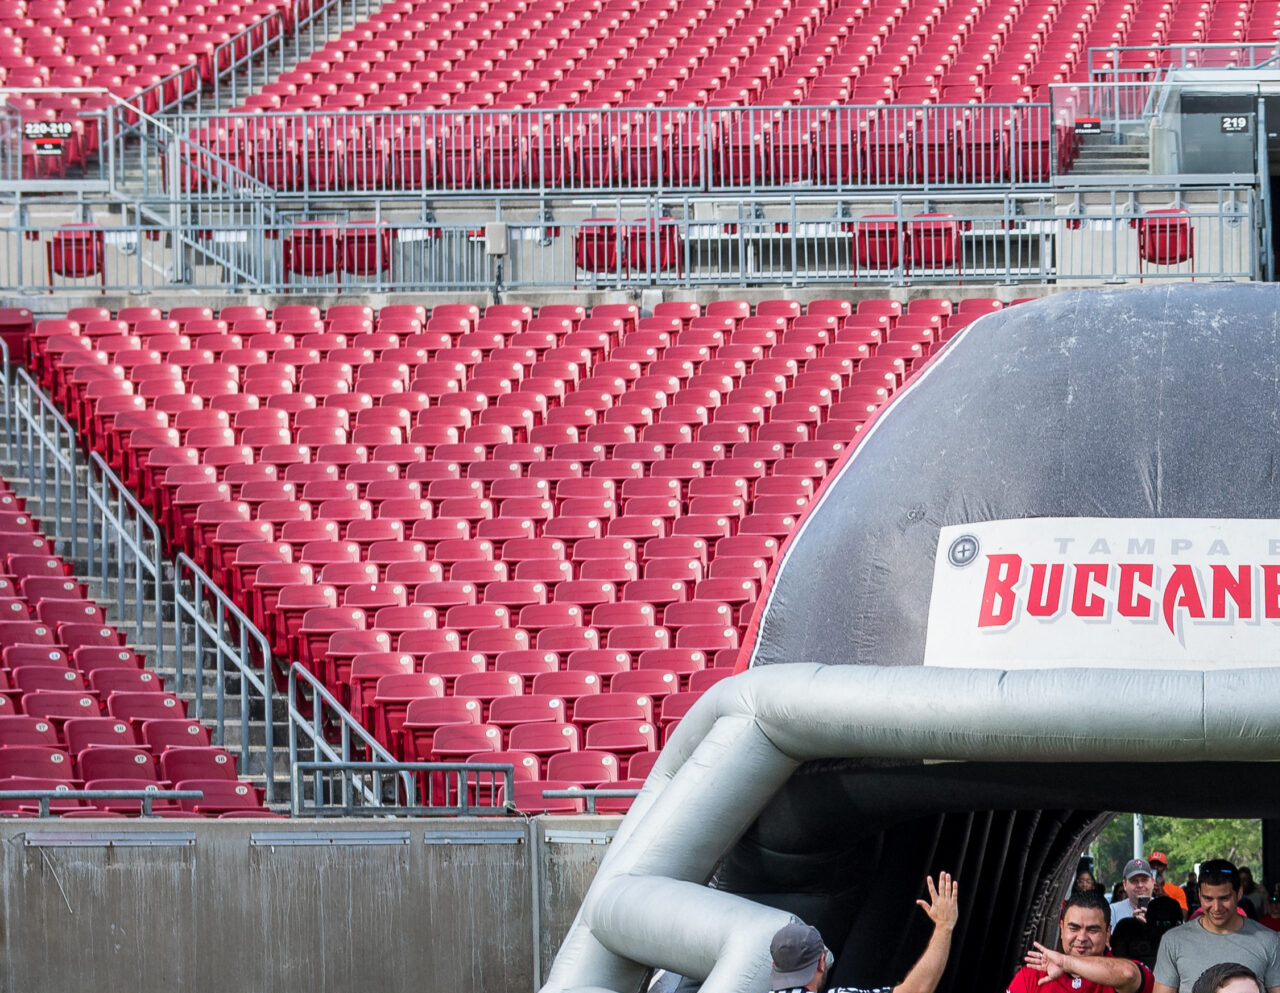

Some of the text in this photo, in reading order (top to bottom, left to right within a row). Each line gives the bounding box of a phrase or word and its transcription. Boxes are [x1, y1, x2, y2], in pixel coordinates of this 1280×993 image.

[25, 122, 72, 134] 220-219
[1222, 117, 1247, 128] 219
[1054, 537, 1231, 556] TAMPA
